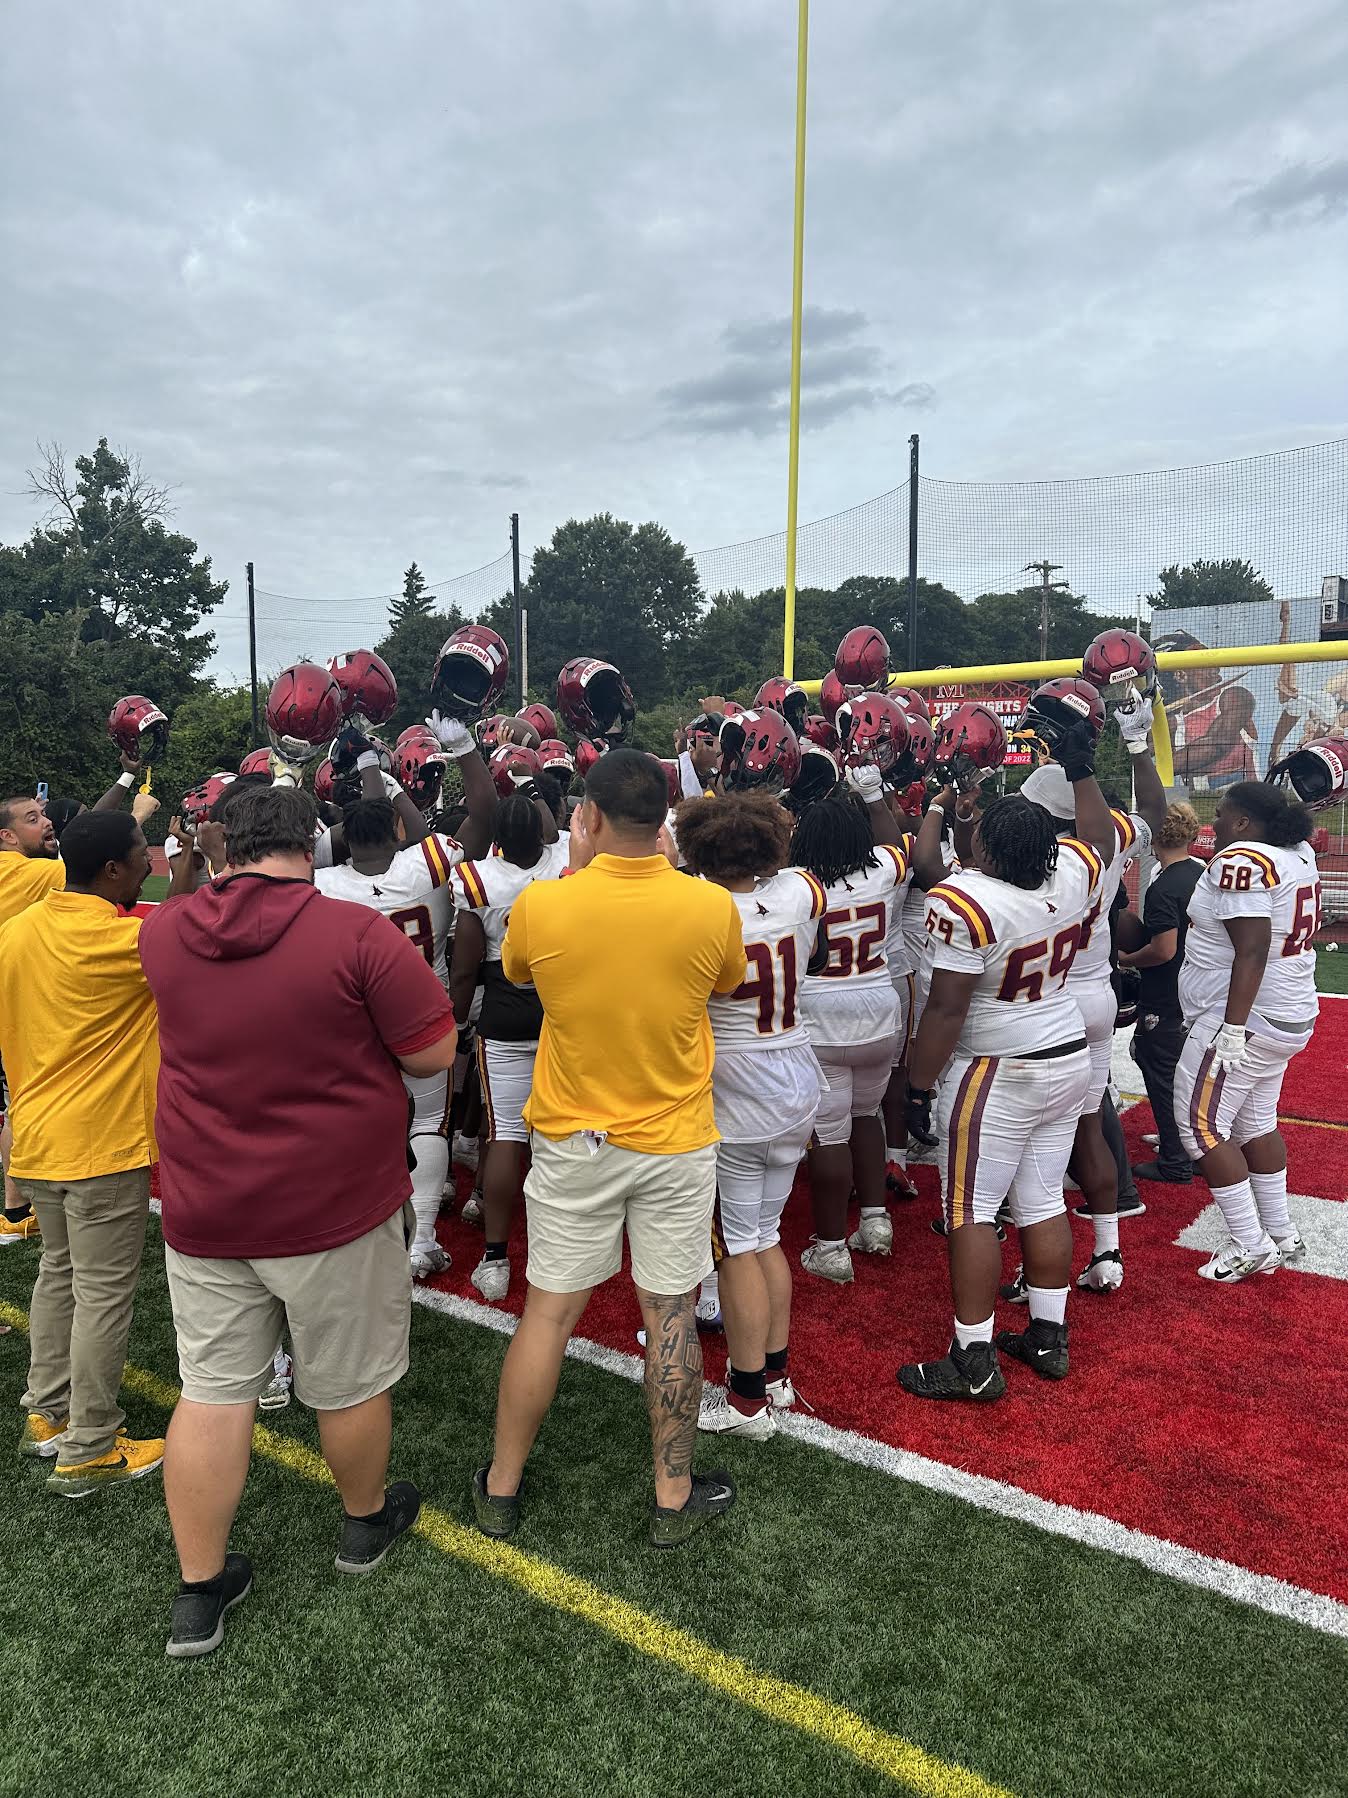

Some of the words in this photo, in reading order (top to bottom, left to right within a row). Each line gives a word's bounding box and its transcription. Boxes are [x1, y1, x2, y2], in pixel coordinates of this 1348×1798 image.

[456, 643, 490, 663] Riddell
[1112, 670, 1135, 680] Riddell
[934, 702, 959, 714] THE
[1066, 695, 1089, 711] Riddell
[1021, 744, 1031, 753] 34
[1321, 749, 1342, 778] Riddell
[1219, 864, 1251, 891] 68
[925, 908, 954, 945] 69
[996, 922, 1082, 1003] 69
[730, 934, 797, 1035] 91
